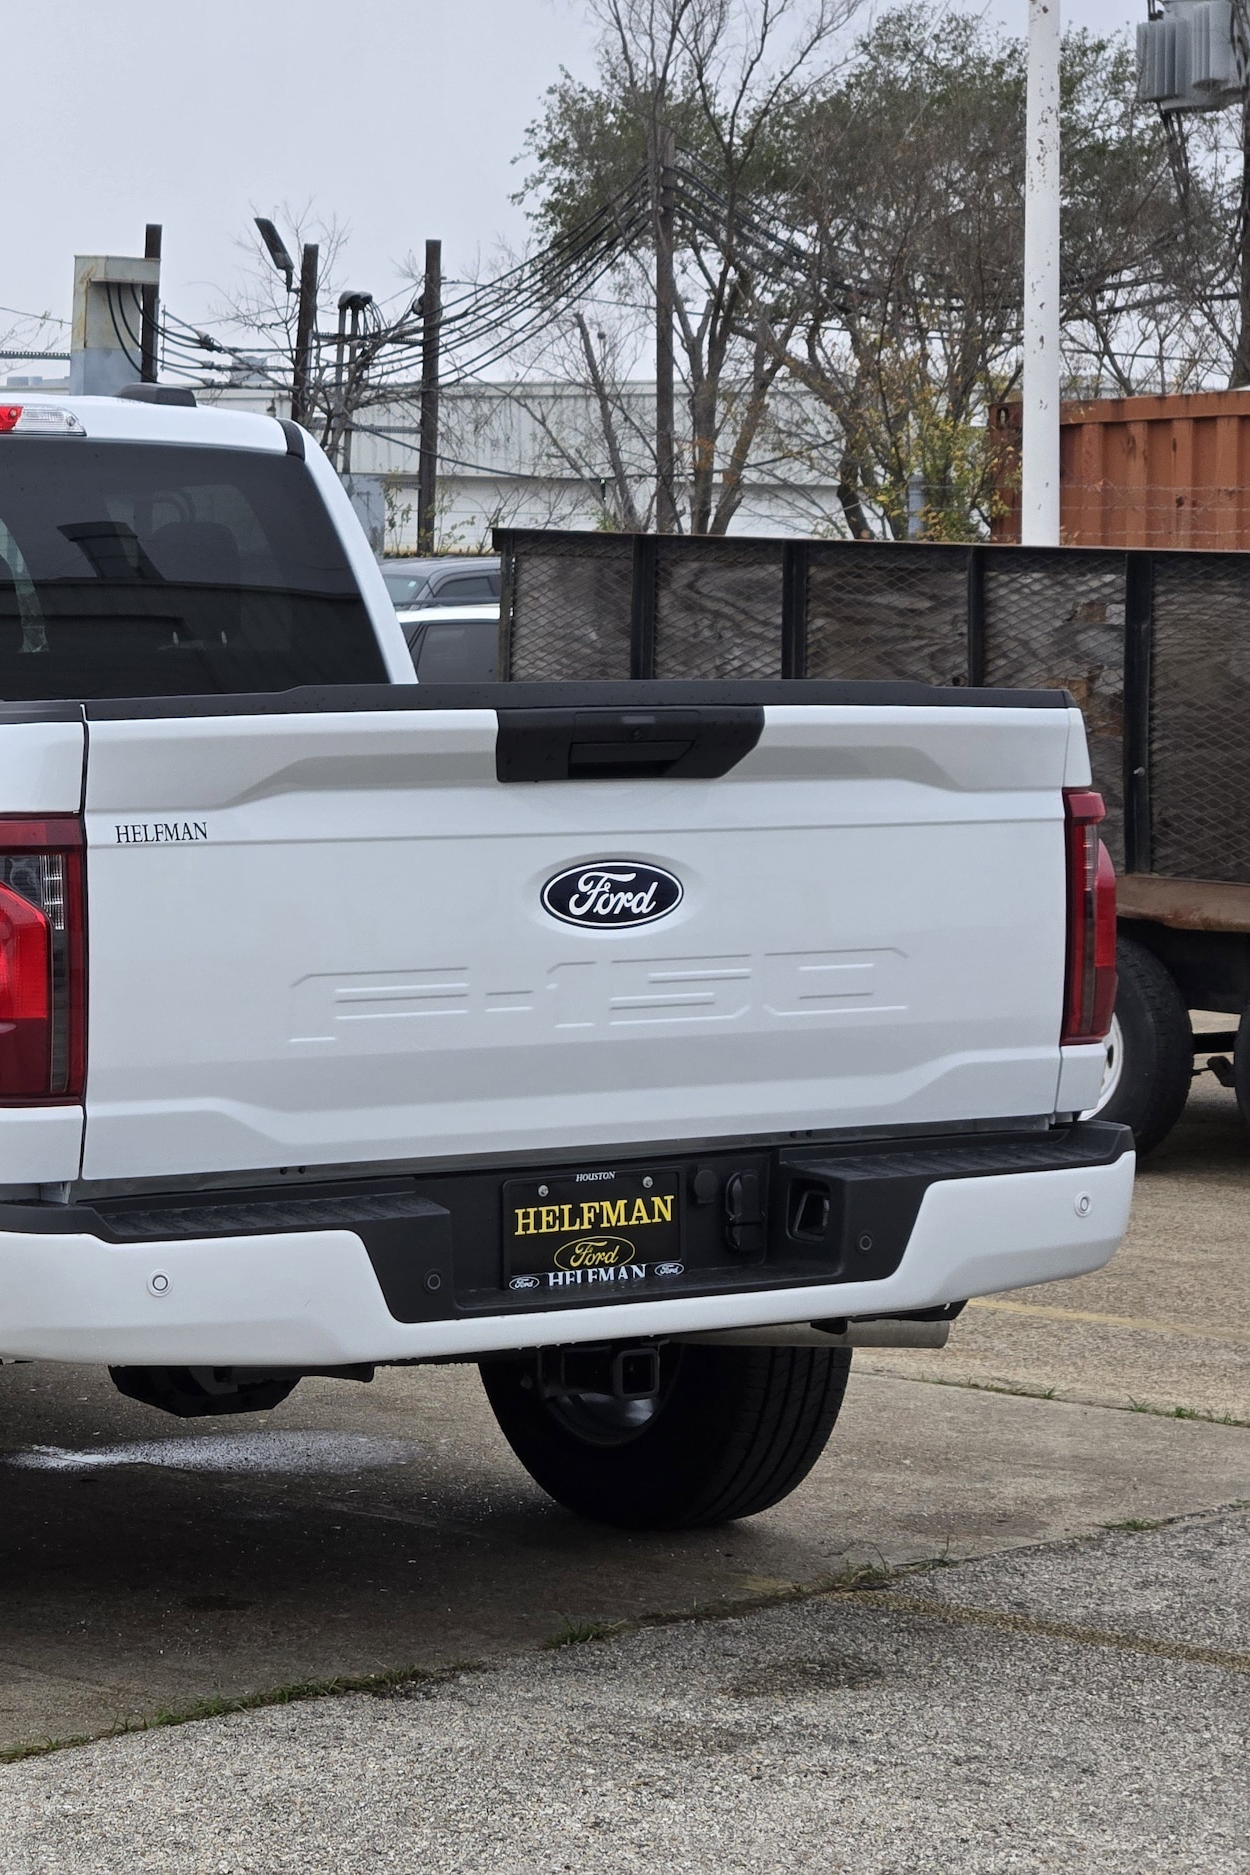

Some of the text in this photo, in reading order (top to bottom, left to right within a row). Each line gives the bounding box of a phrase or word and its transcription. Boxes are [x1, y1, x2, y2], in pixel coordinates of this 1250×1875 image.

[114, 821, 208, 843] HELFMAN
[568, 871, 658, 916] Ford
[290, 946, 908, 1043] F-150
[575, 1171, 616, 1182] HOUSTON
[514, 1195, 675, 1236] HELFMAN
[569, 1240, 620, 1267] Ford
